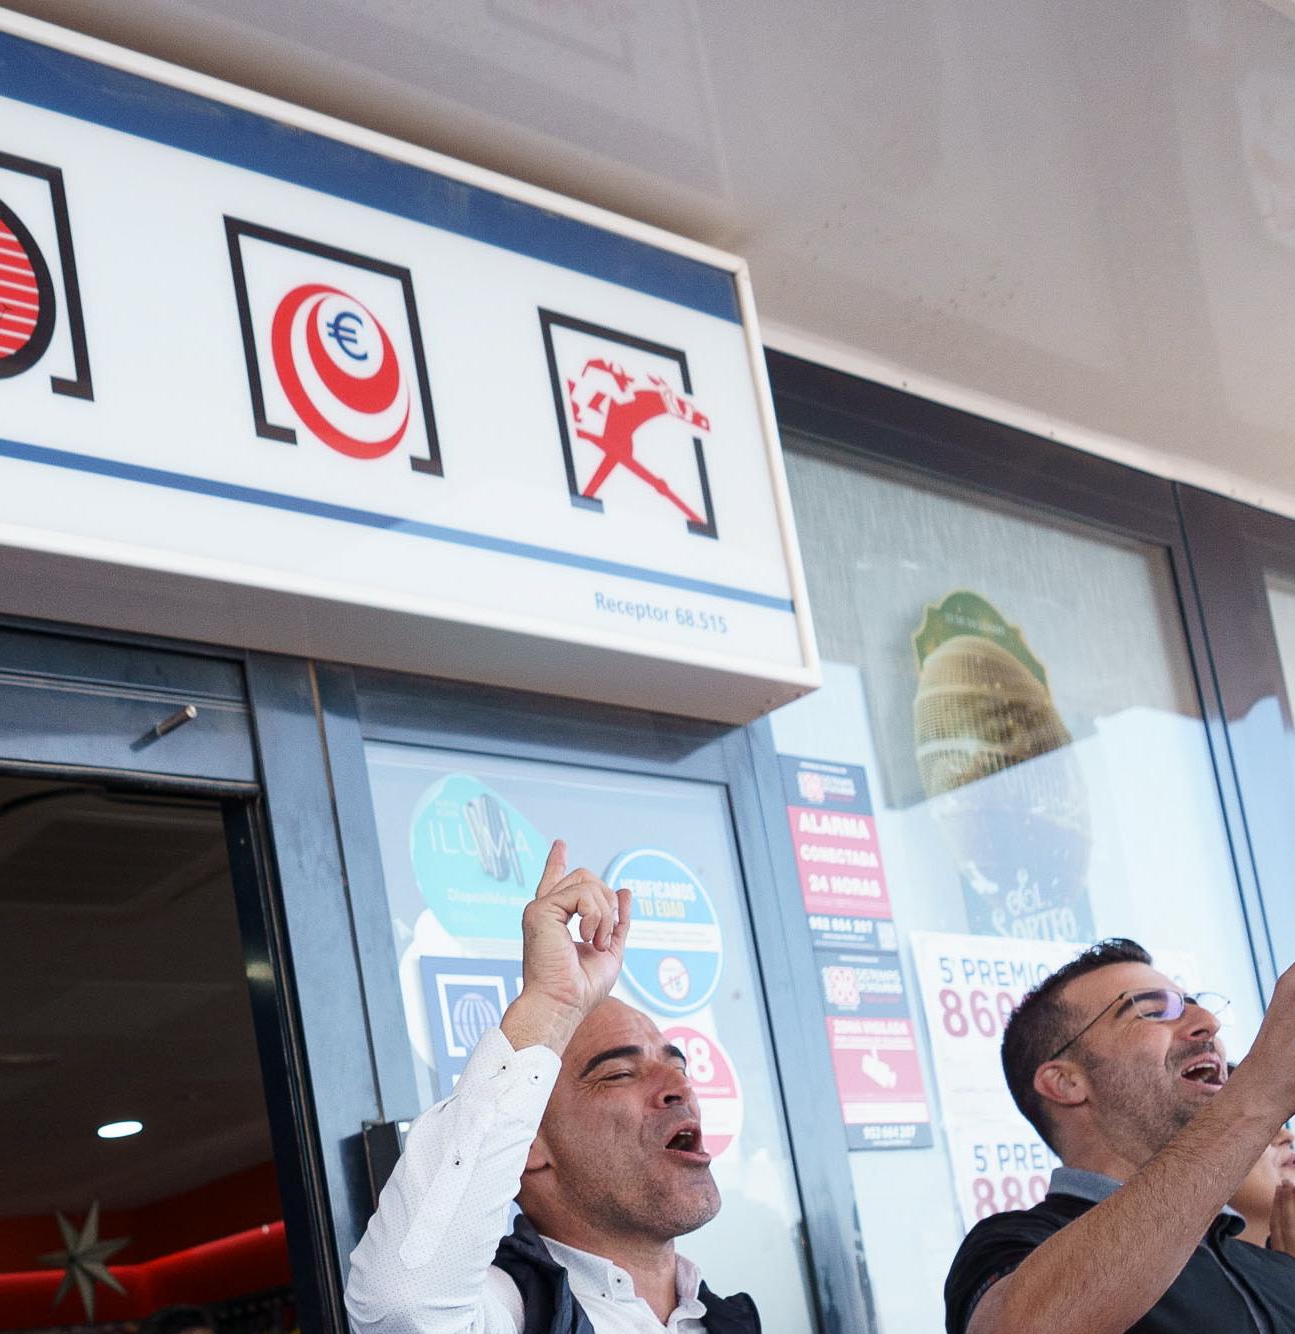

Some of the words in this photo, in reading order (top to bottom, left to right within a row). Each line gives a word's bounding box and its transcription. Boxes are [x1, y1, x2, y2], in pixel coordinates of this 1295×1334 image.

[594, 591, 670, 622] Receptor
[675, 607, 728, 634] 68.515
[798, 811, 871, 841] ALARMA
[800, 844, 880, 868] CONECTADA
[808, 874, 830, 894] 24
[830, 876, 882, 898] HORAS
